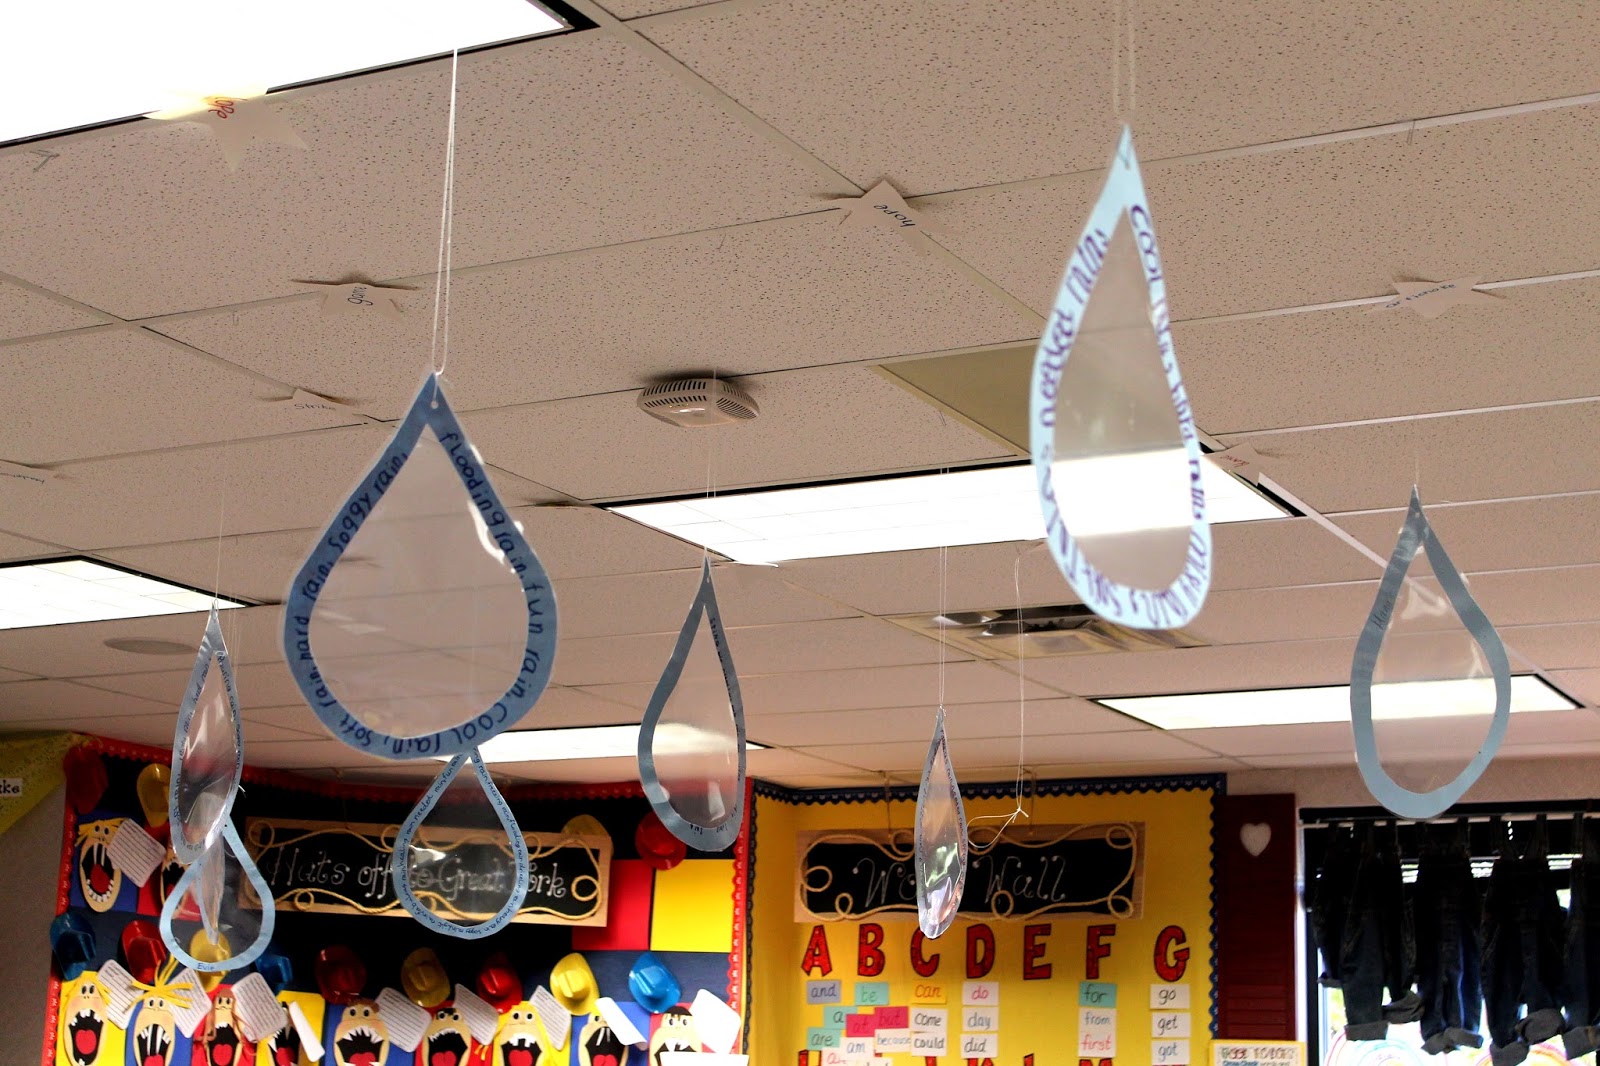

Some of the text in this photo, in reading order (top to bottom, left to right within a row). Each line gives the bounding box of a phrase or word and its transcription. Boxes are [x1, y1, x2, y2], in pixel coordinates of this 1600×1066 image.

[873, 204, 916, 228] hope
[439, 432, 506, 534] flooding
[524, 581, 544, 636] fun
[299, 616, 311, 662] hard
[414, 794, 434, 821] needed
[267, 845, 350, 886] Hats
[357, 852, 395, 900] off
[508, 861, 568, 899] ork
[853, 857, 919, 908] Wo
[972, 855, 1067, 905] Wall
[801, 923, 1190, 982] A B C D E F G
[811, 985, 837, 998] and
[914, 984, 942, 998] can
[971, 985, 989, 1000] do
[1084, 984, 1108, 1003] for
[1159, 988, 1177, 1006] go
[833, 1011, 844, 1024] a
[878, 1013, 901, 1027] but
[914, 1012, 942, 1027] come
[967, 1012, 991, 1030] day
[1085, 1011, 1111, 1025] from
[1158, 1015, 1178, 1036] get
[811, 1033, 834, 1047] are
[846, 1041, 866, 1053] am
[914, 1036, 945, 1050] could
[964, 1038, 987, 1053] did
[1082, 1033, 1112, 1051] first
[1158, 1045, 1177, 1062] got
